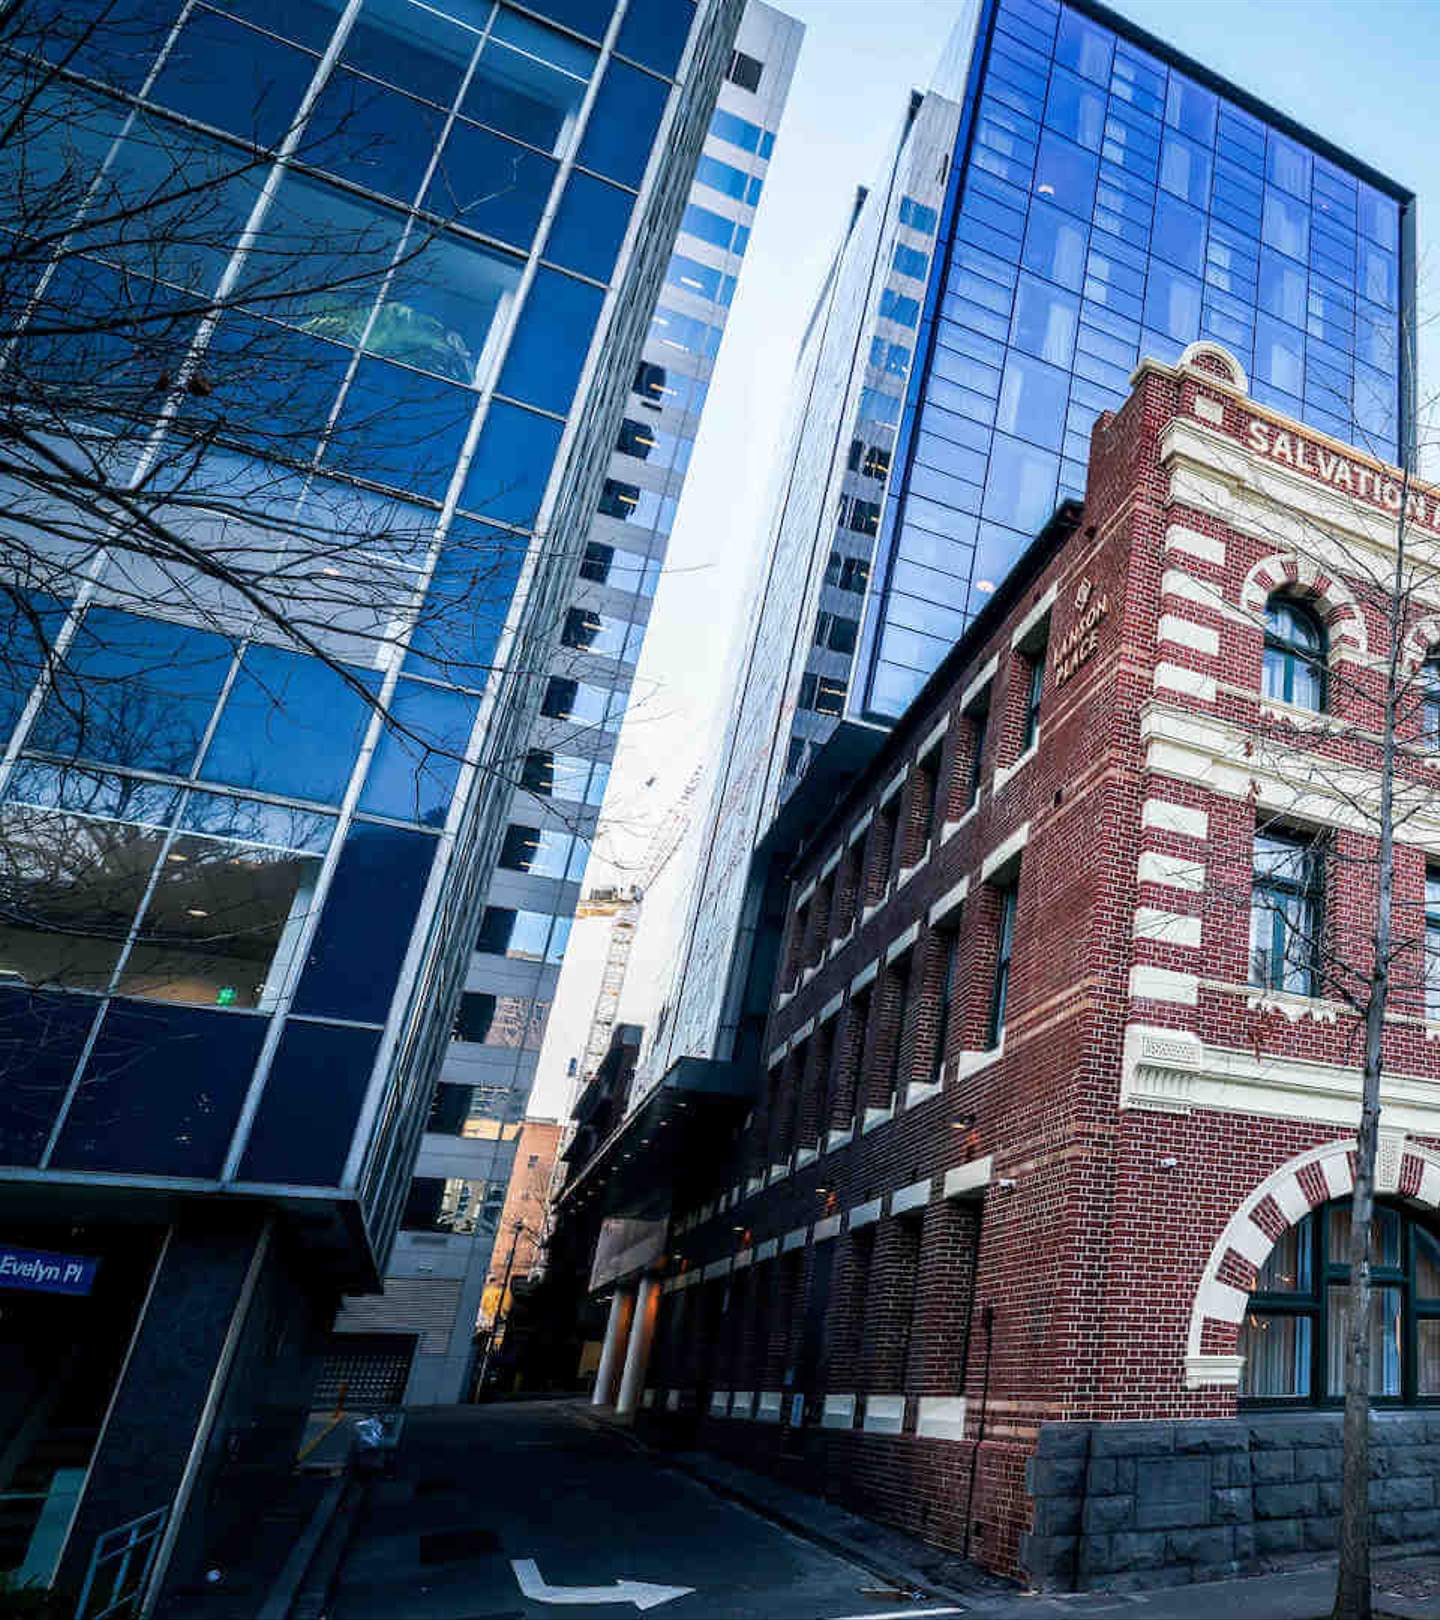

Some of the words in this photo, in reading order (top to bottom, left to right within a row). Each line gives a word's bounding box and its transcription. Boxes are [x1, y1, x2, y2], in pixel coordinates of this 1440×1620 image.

[1249, 418, 1426, 521] SALVATION
[0, 1255, 61, 1282] Evelyn
[63, 1263, 83, 1282] Pl
